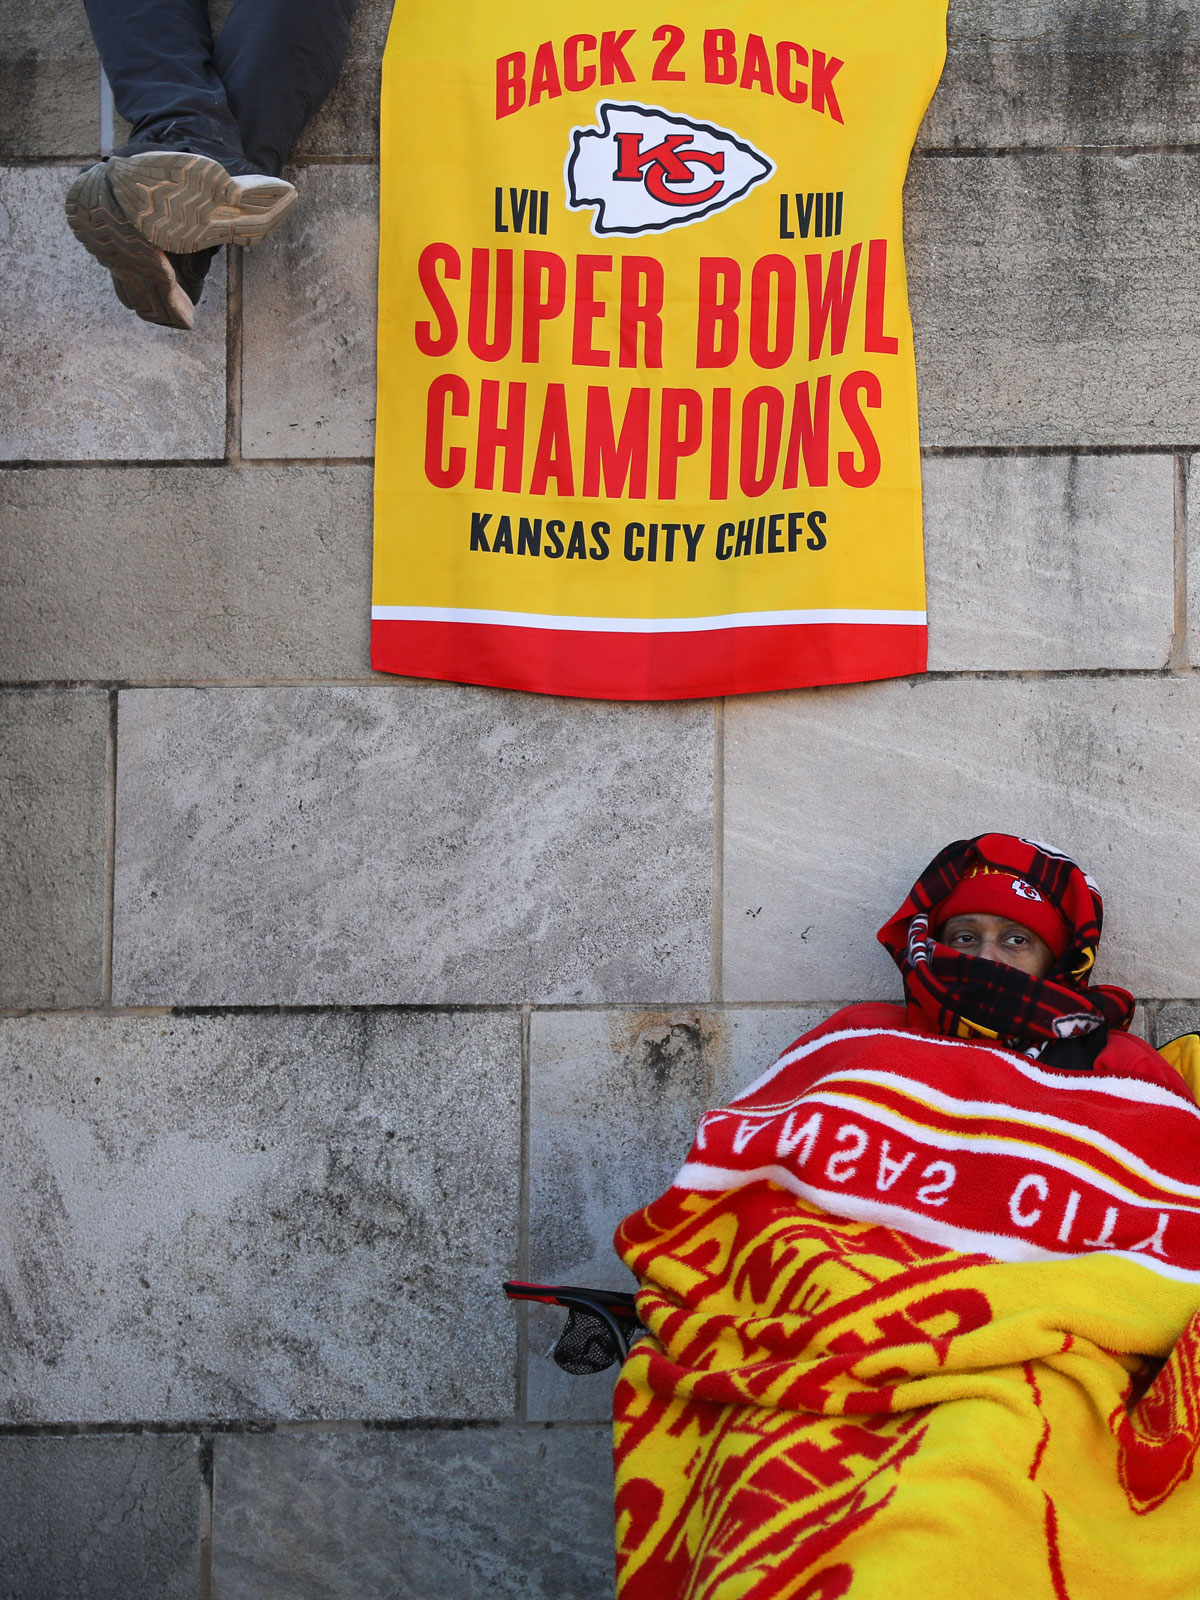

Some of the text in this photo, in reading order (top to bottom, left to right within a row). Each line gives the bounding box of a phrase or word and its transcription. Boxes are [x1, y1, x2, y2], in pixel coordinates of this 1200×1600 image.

[495, 24, 845, 125] BACK 2 BACK
[613, 132, 725, 207] KC
[495, 187, 549, 236] LVII
[779, 191, 844, 240] LVIII
[414, 238, 899, 370] SUPER BOWL
[424, 370, 882, 501] CHAMPIONS
[469, 510, 827, 562] KANSAS CITY CHIEFS
